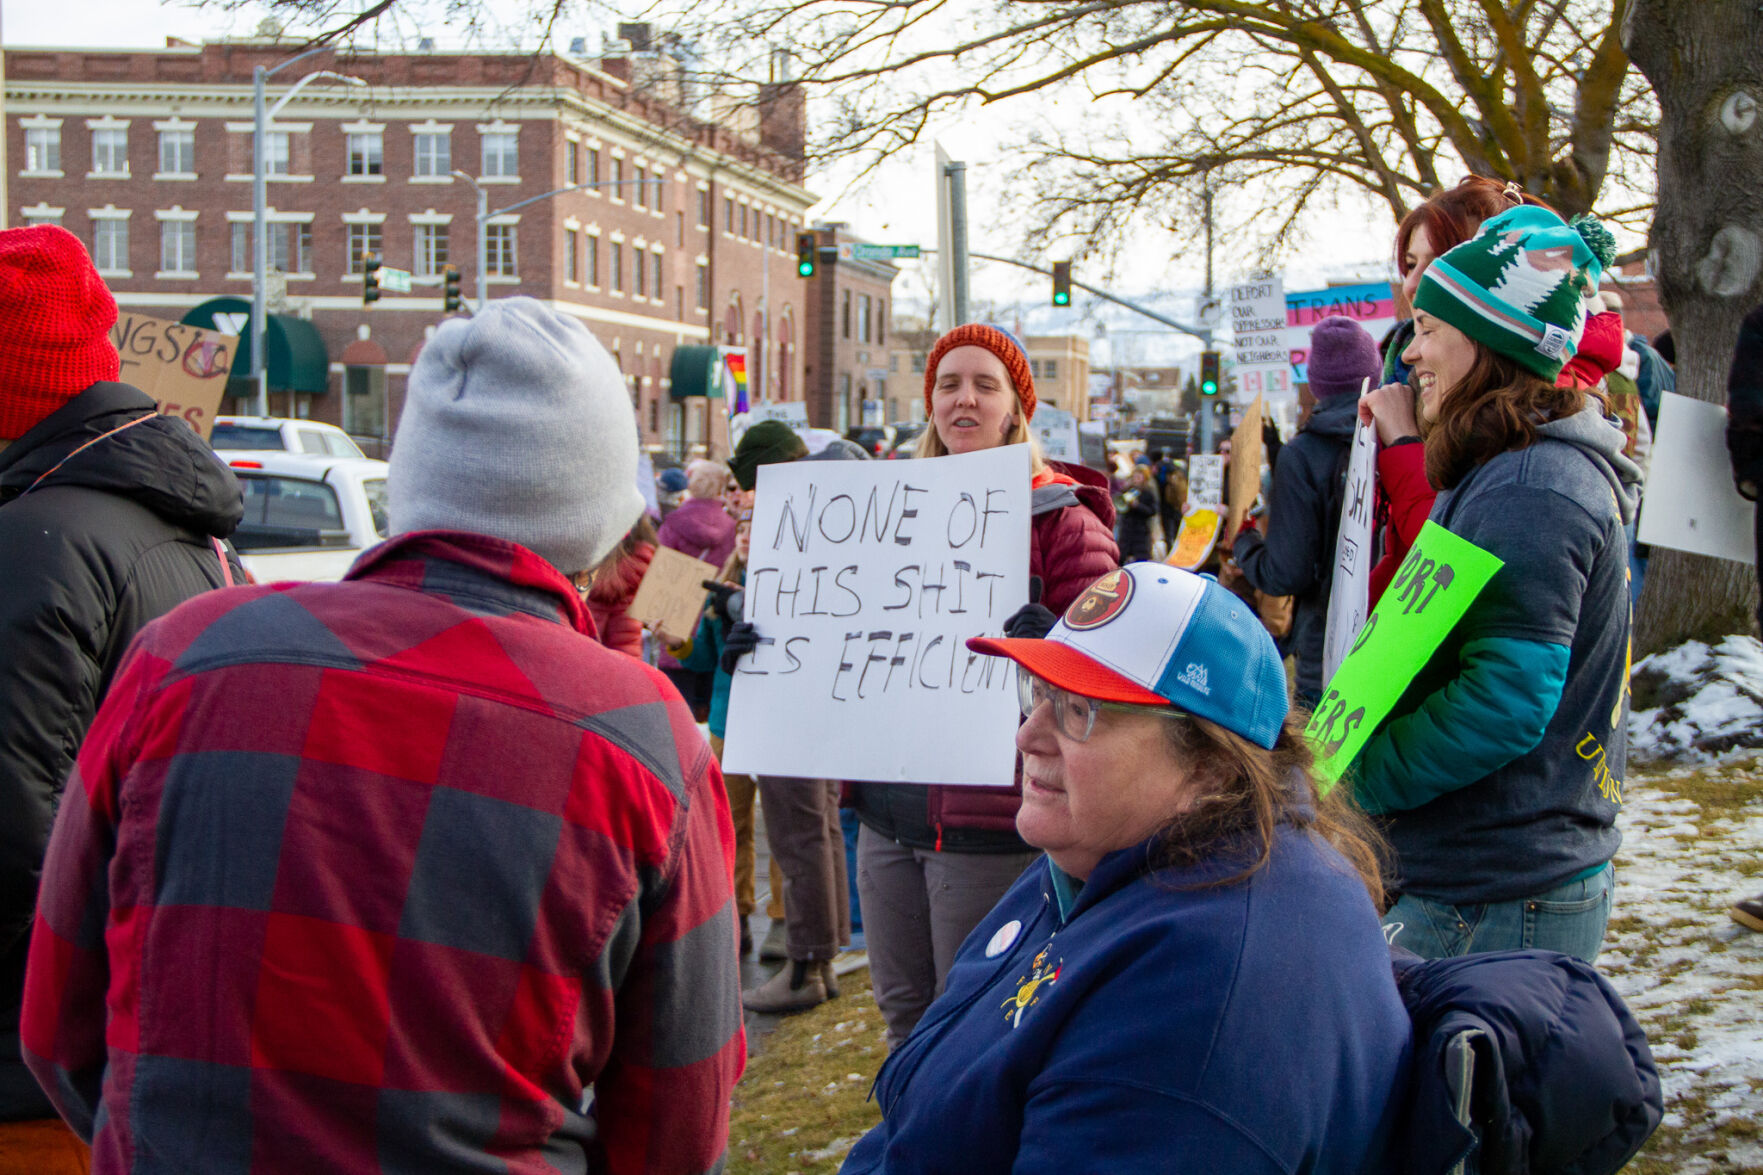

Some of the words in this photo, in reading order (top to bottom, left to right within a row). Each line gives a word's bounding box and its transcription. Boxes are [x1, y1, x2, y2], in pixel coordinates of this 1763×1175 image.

[1231, 284, 1273, 302] DEPORT
[1232, 306, 1256, 318] OUR
[1286, 293, 1378, 324] TRANS
[1234, 336, 1252, 348] NOT
[1254, 335, 1278, 347] OUR
[1236, 350, 1288, 363] NEIGHBORS
[773, 480, 929, 553] NONE
[947, 488, 1009, 549] OF
[752, 565, 862, 619] THIS
[883, 560, 1005, 619] SHIT
[736, 636, 811, 675] IS
